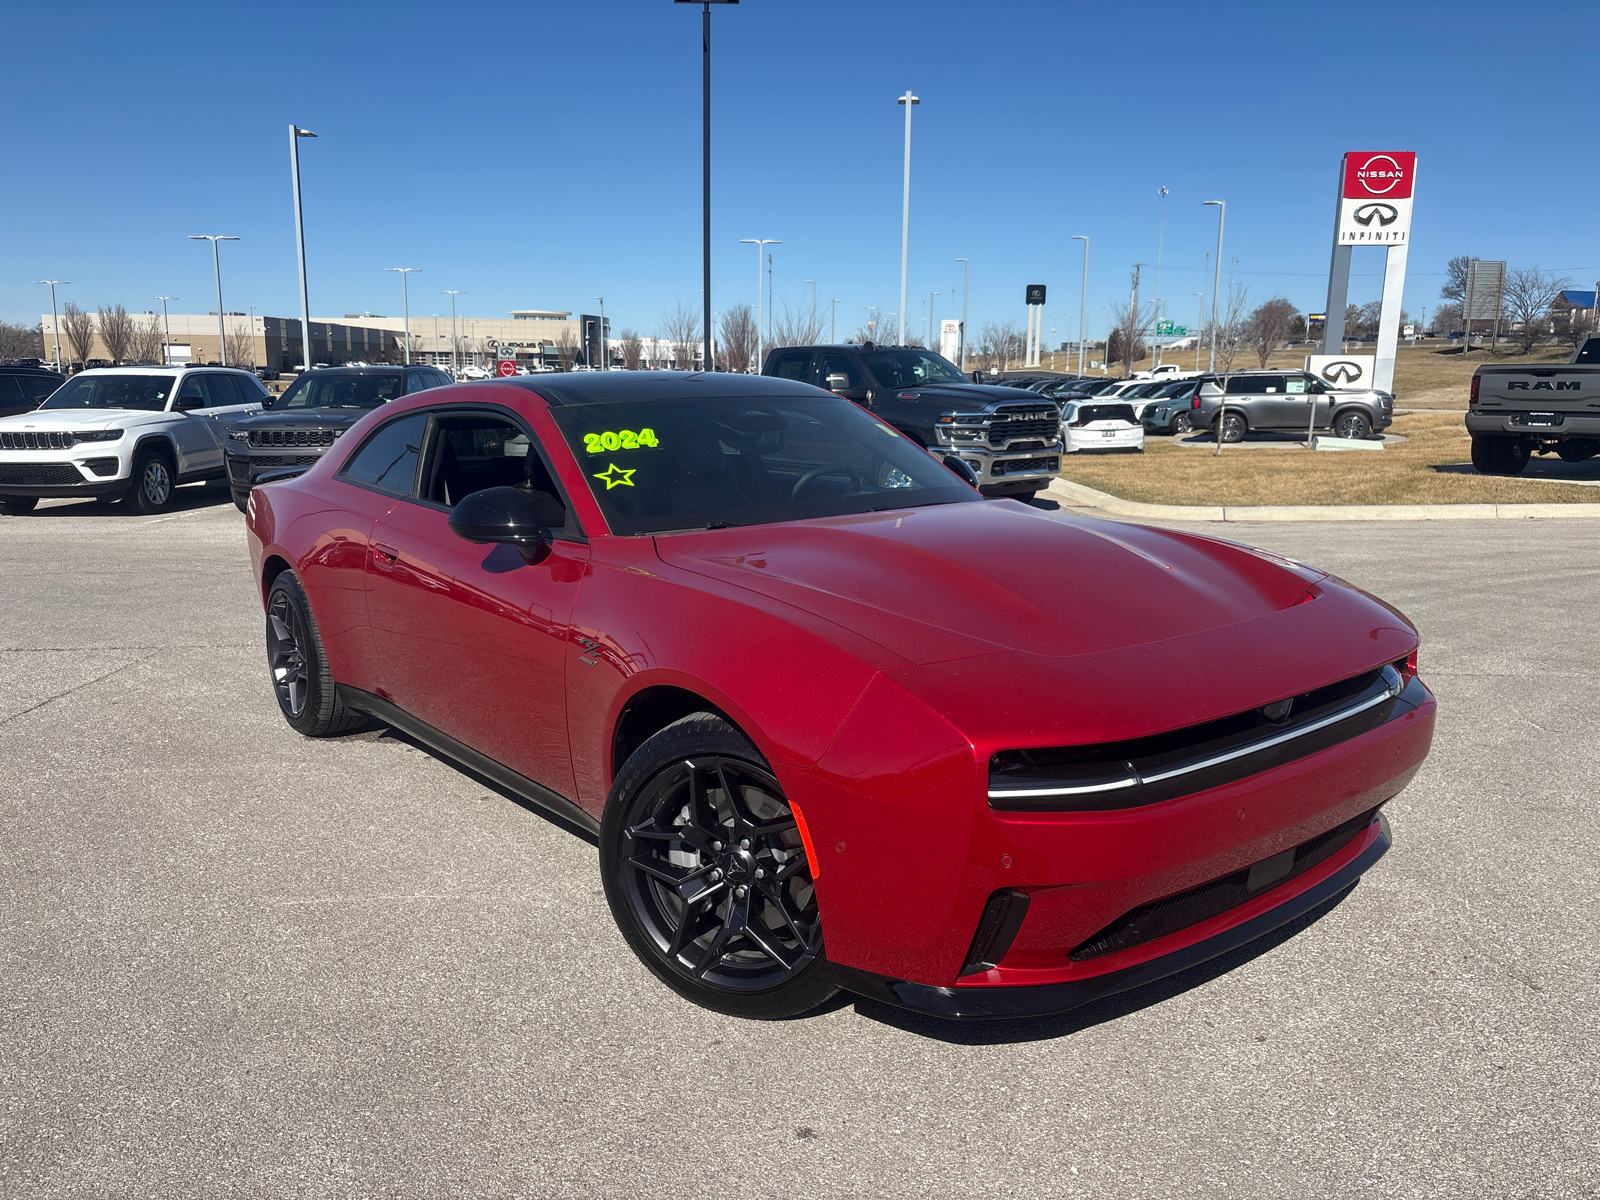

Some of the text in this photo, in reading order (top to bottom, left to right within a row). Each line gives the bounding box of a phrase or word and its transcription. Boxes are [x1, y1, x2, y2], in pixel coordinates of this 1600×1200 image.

[1342, 232, 1405, 241] INFINITI
[1507, 381, 1582, 391] RAM
[1012, 412, 1047, 421] RAM
[583, 428, 660, 454] 2024
